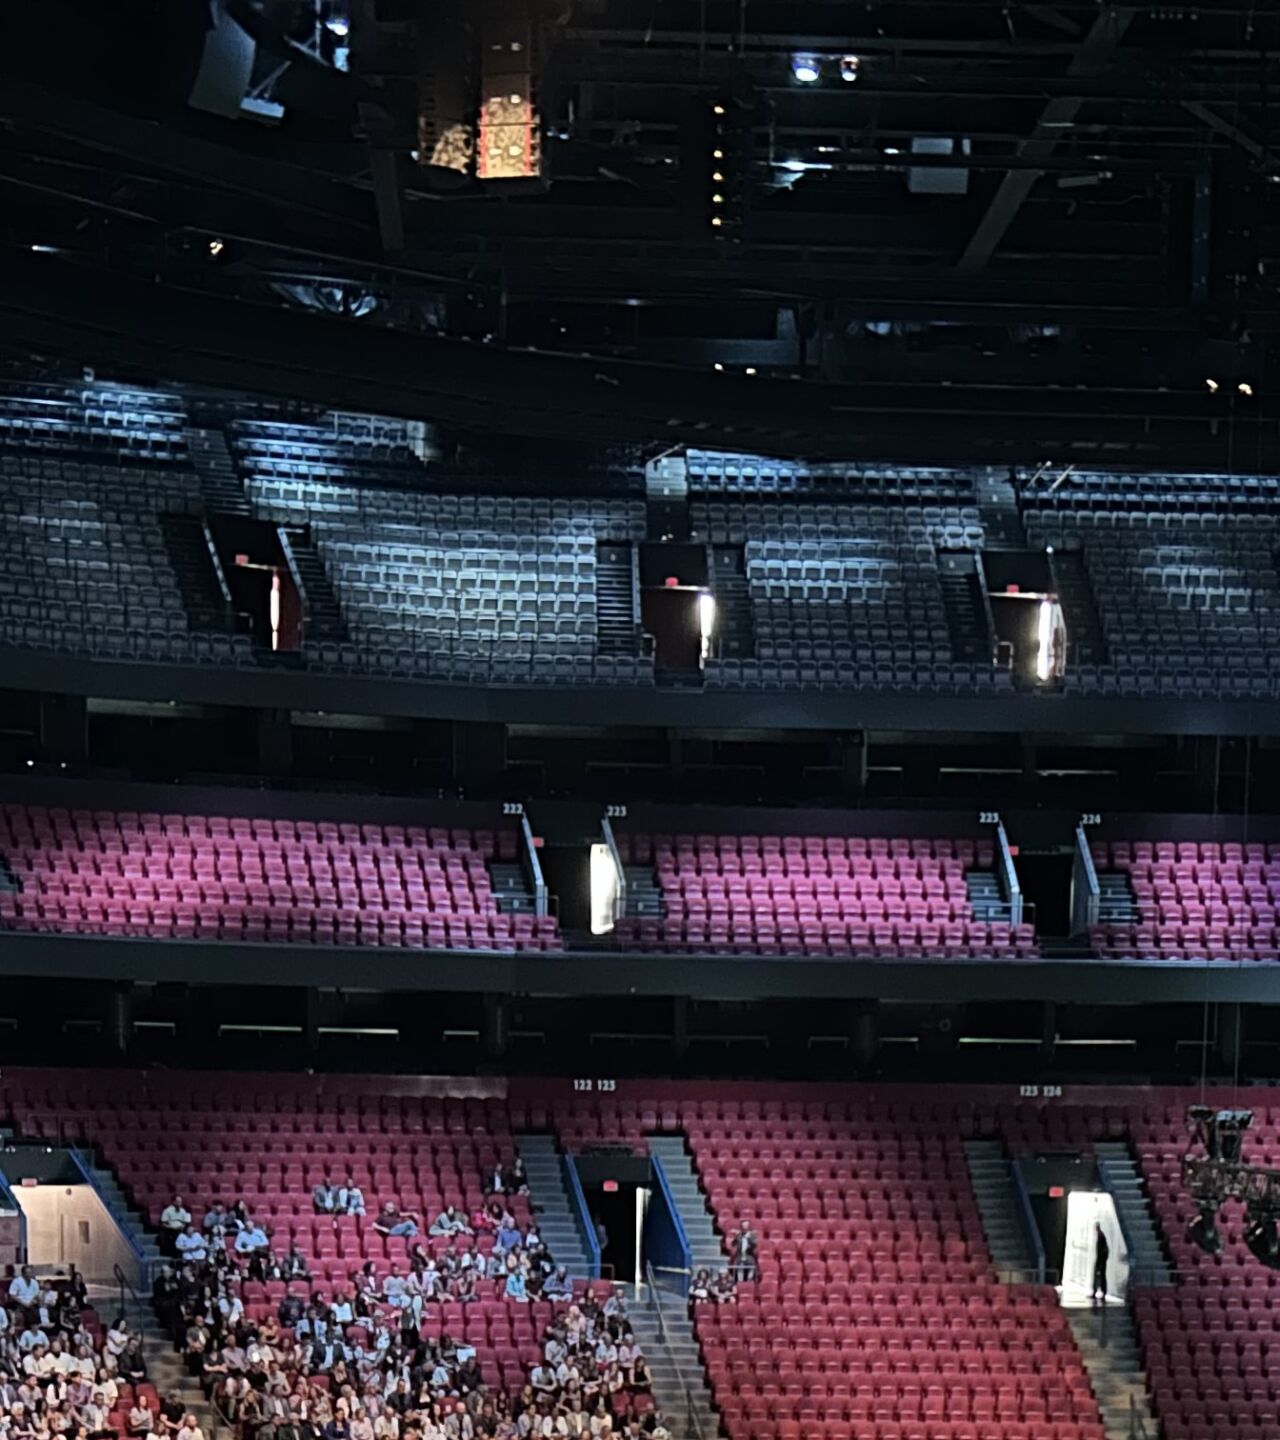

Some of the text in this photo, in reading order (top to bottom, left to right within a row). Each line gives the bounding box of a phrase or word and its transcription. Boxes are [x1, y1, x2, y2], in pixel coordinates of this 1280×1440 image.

[503, 803, 523, 815] 222
[574, 1079, 616, 1091] 122 123
